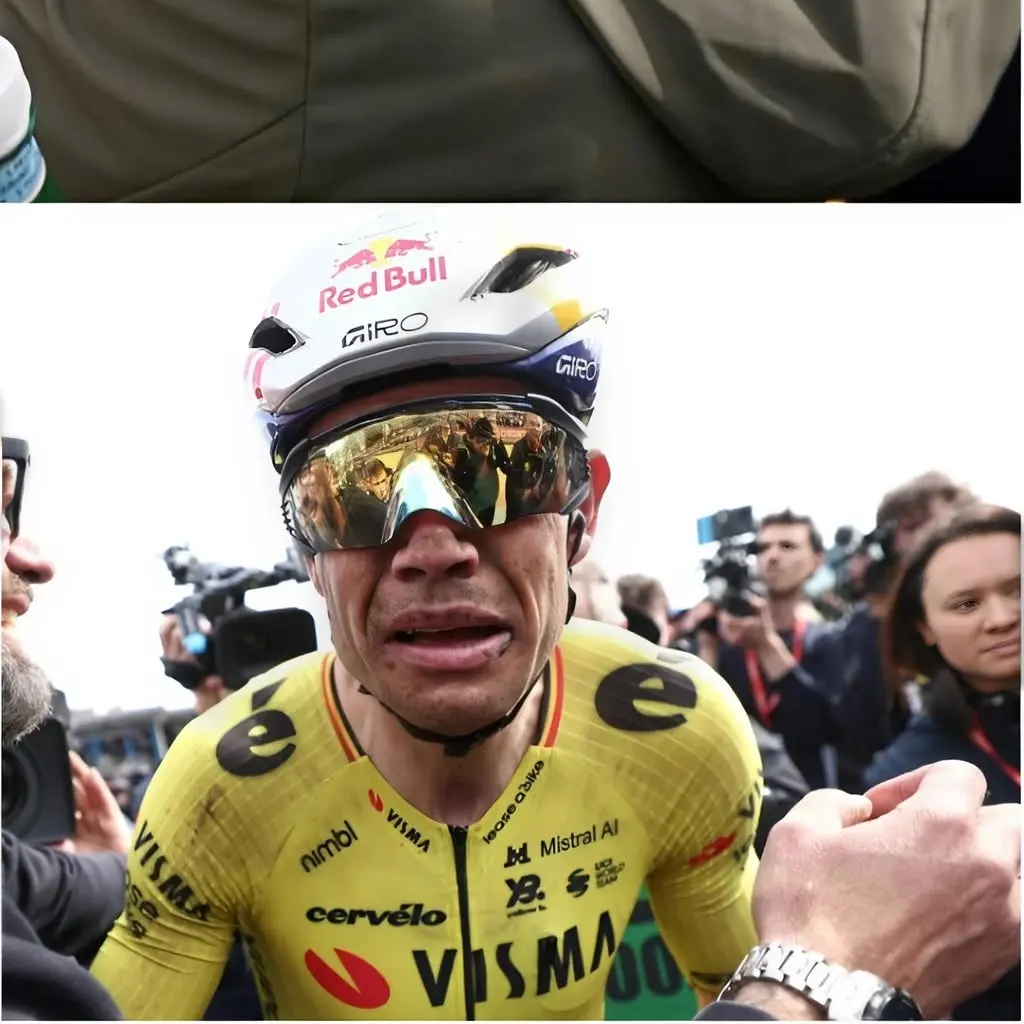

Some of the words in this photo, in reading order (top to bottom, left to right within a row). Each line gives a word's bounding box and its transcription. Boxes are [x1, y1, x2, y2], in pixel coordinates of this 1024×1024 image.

[319, 272, 377, 313] Red
[384, 256, 447, 292] Bull
[342, 312, 428, 348] GIRO
[556, 355, 600, 382] GIRO
[387, 808, 430, 852] VISMA
[483, 804, 516, 844] lease
[541, 825, 596, 857] Mistral
[601, 818, 619, 840] AI
[300, 820, 358, 872] nimbl
[134, 820, 210, 921] VISMA
[305, 904, 447, 927] cervélo
[412, 910, 618, 1008] VISMA
